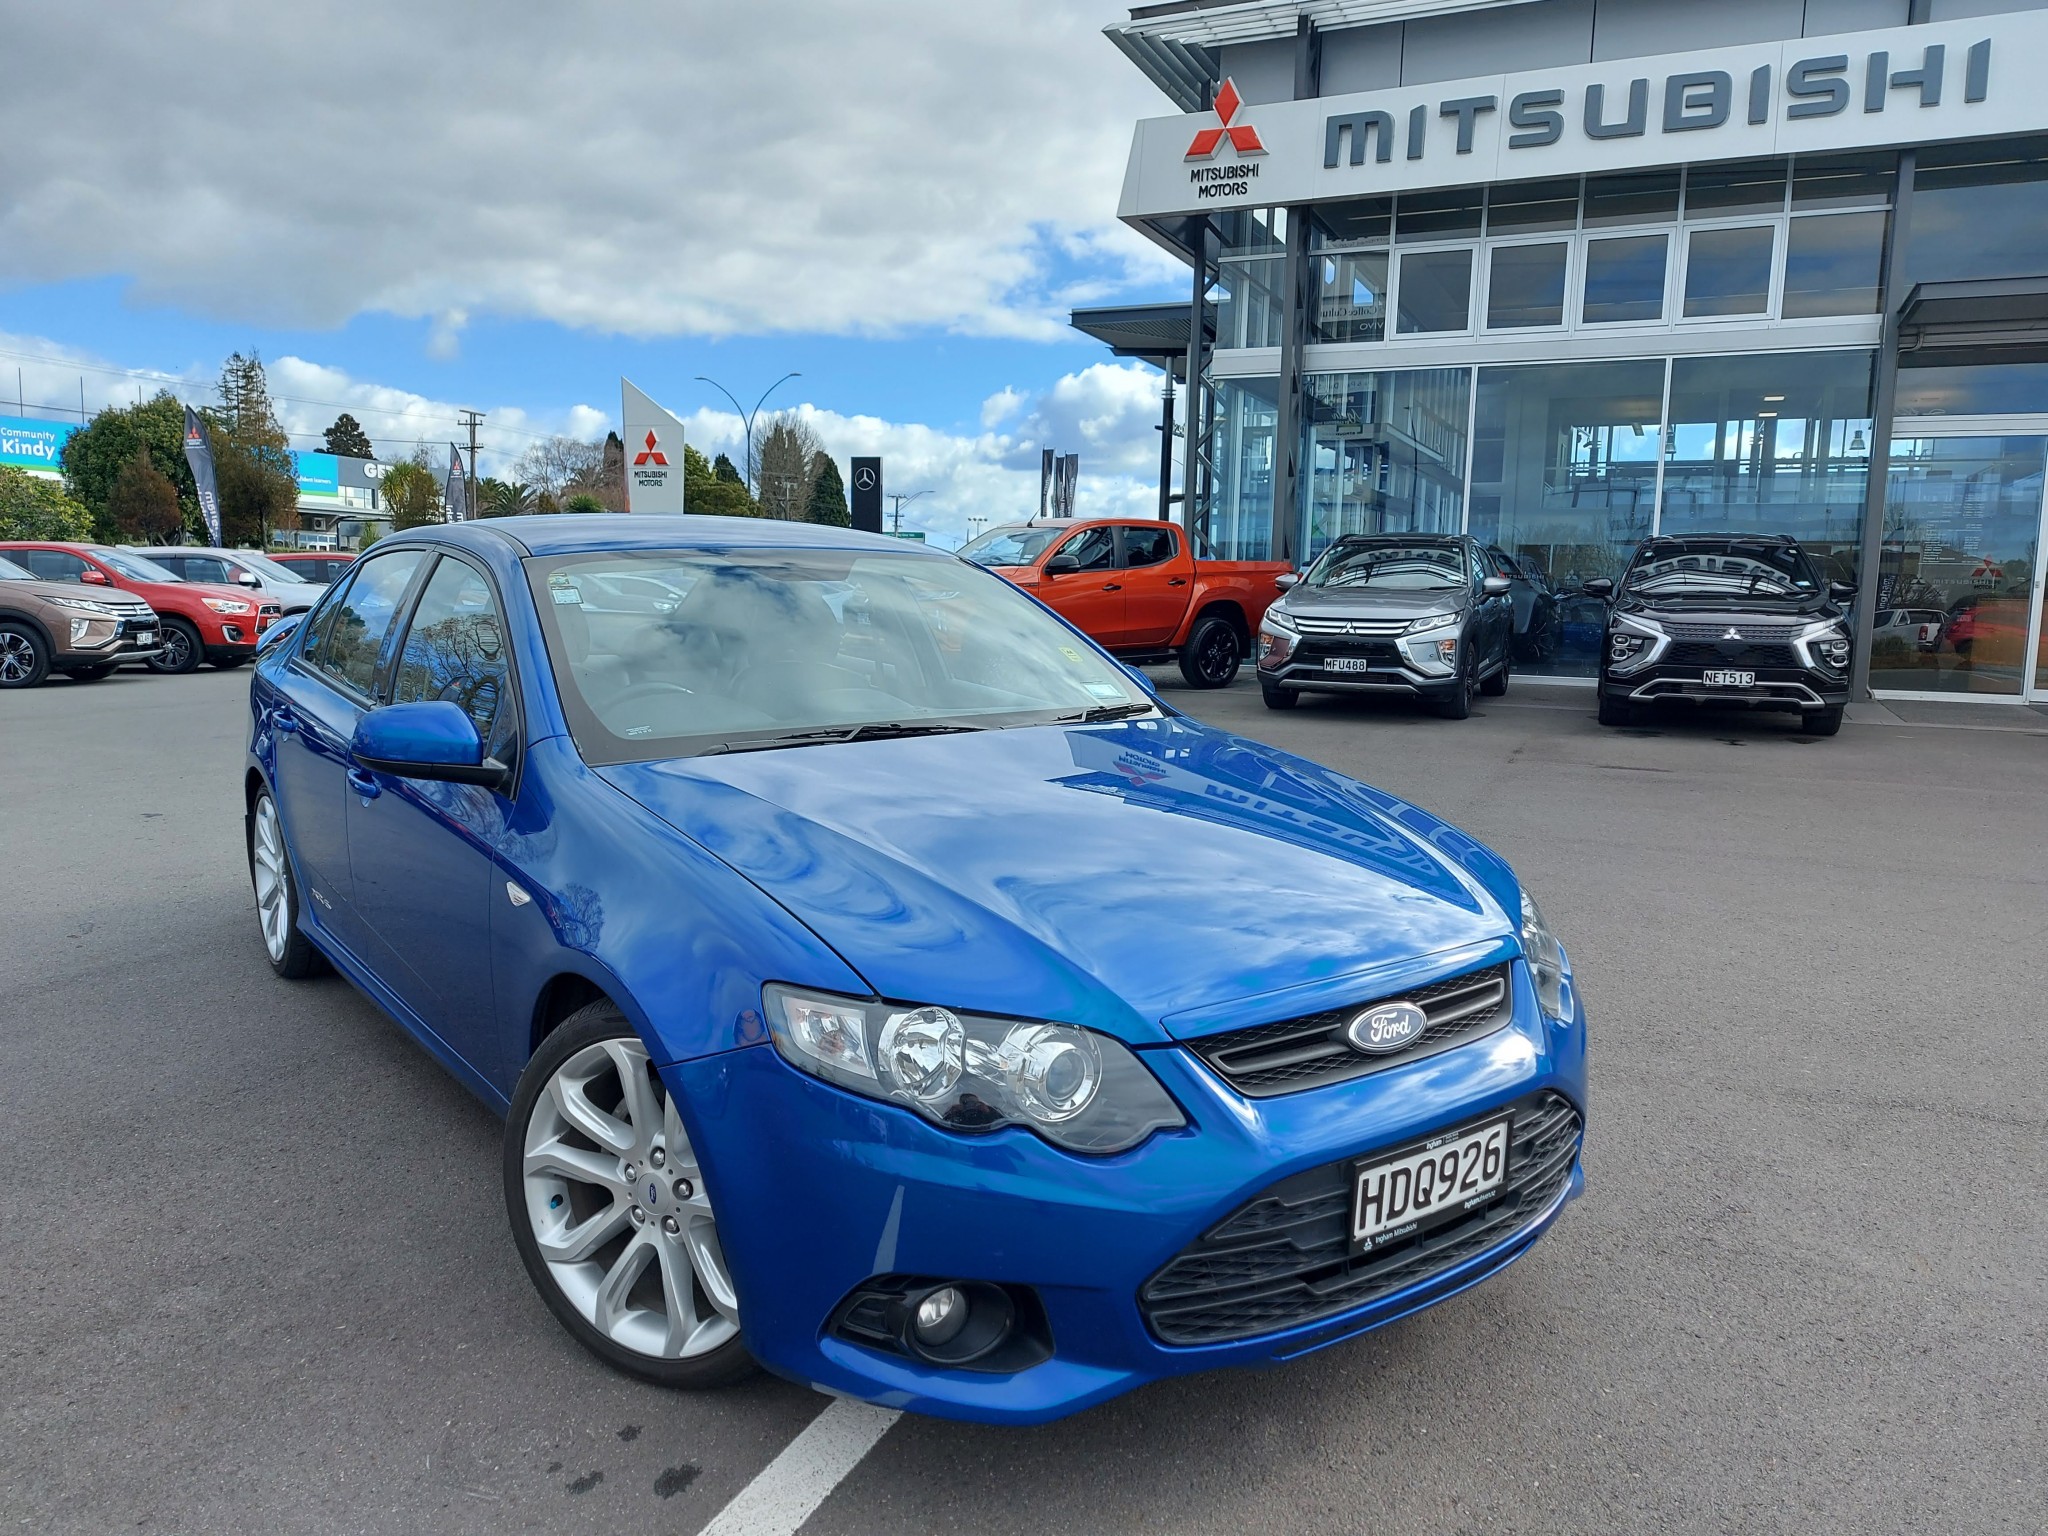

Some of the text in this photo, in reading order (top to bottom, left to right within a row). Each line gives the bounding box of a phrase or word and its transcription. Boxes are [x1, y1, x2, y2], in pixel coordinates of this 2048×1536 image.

[1323, 37, 1992, 169] MITSUBISHI
[1190, 163, 1259, 183] MITSUBISHI
[1198, 181, 1248, 199] MOTORS
[0, 427, 55, 443] Community
[2, 438, 56, 461] Kindy
[633, 470, 668, 479] MITSUBISHI
[638, 479, 663, 487] MOTORS
[1325, 659, 1365, 671] MFU488
[1704, 672, 1754, 684] NET513
[1370, 1011, 1412, 1043] Ford
[1358, 1129, 1501, 1231] HDQ926
[1375, 1221, 1418, 1245] Ingham Mitsubishi
